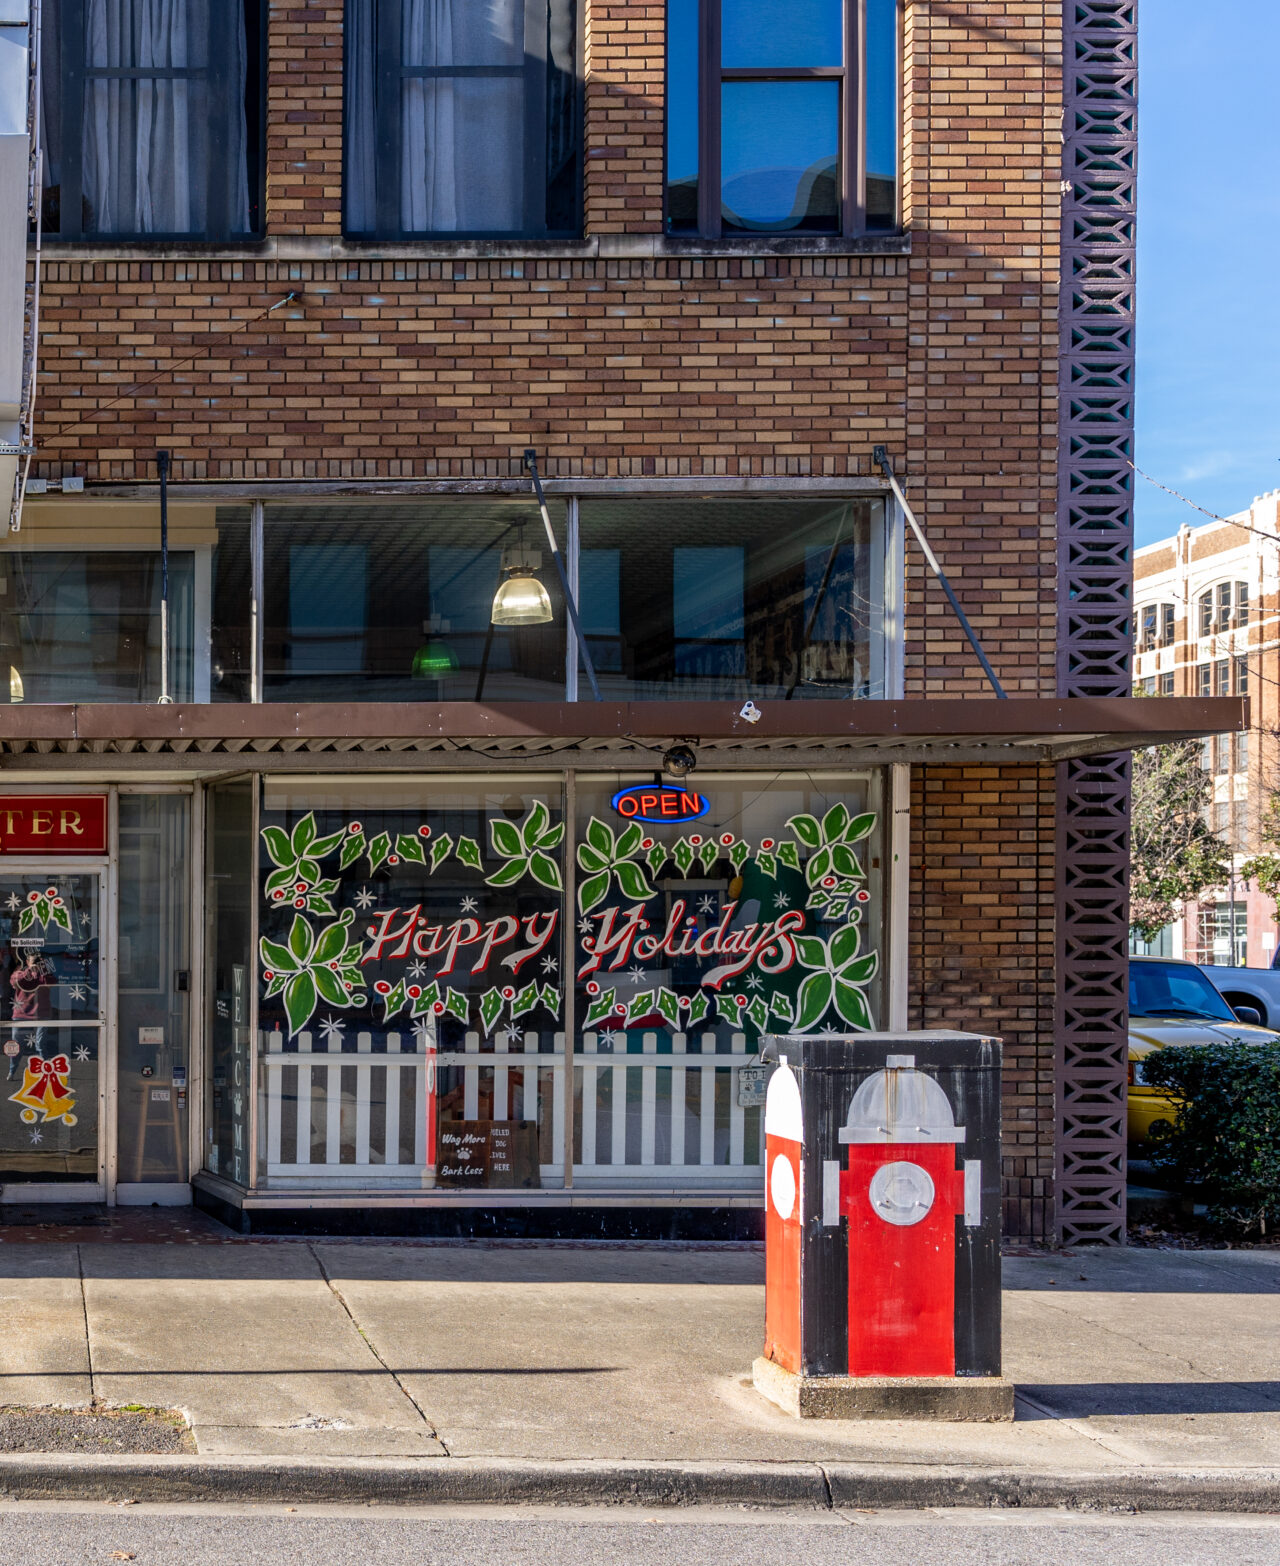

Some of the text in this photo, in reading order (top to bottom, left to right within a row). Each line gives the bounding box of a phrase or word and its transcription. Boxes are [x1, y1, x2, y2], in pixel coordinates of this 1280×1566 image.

[617, 791, 701, 819] OPEN
[20, 939, 43, 947] Soliciting
[360, 899, 807, 990] Happy Holidays
[744, 1070, 758, 1080] TO
[441, 1133, 486, 1146] Wag More
[489, 1151, 506, 1159] IVES
[440, 1164, 484, 1176] Bark Less
